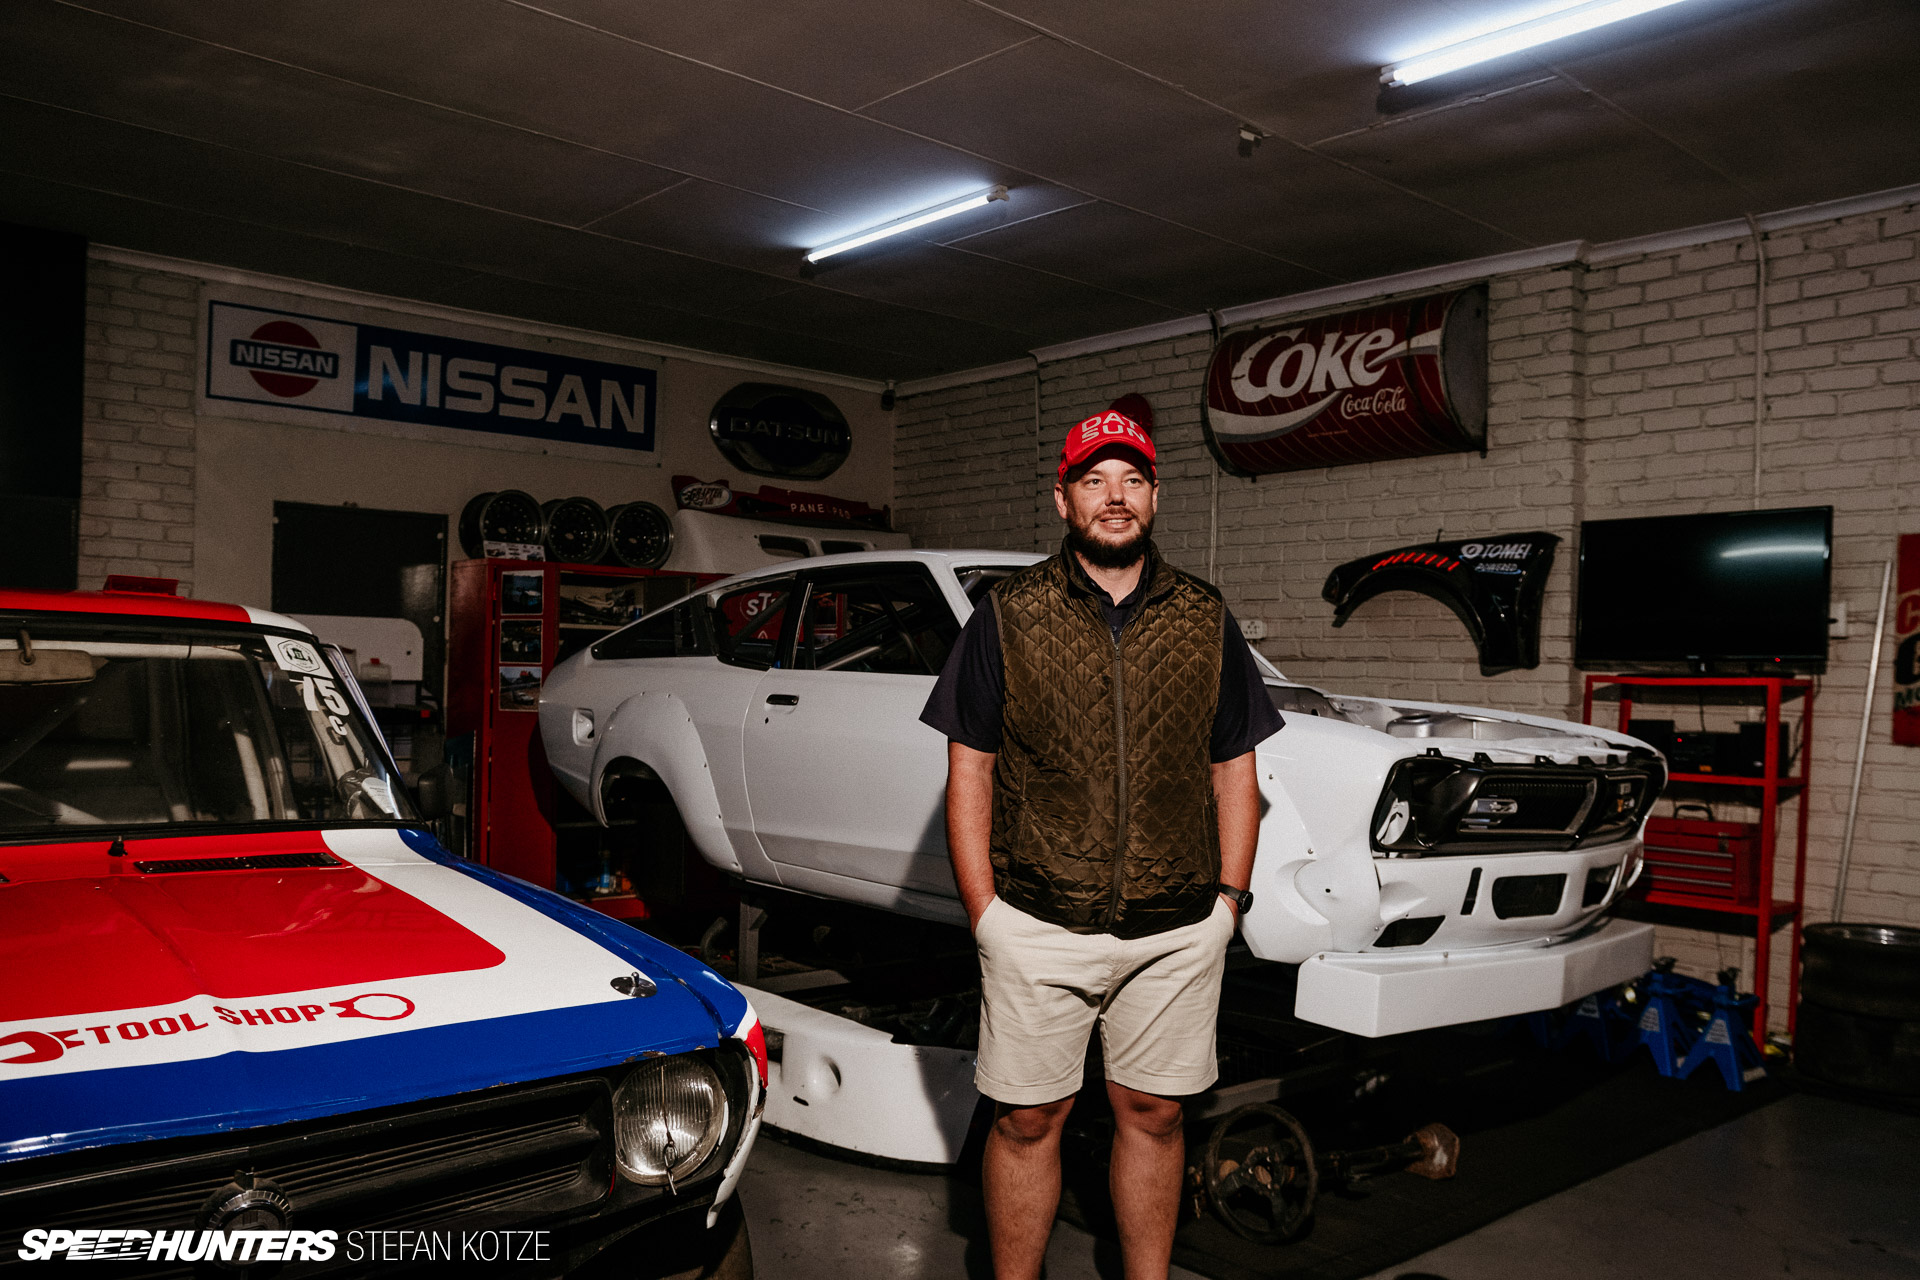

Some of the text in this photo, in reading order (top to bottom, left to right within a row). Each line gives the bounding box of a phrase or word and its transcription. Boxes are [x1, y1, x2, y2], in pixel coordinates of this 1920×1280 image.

[234, 345, 335, 374] NISSAN
[367, 345, 646, 434] NISSAN
[729, 416, 840, 446] DATSUN
[1481, 543, 1533, 560] TOMEI
[745, 592, 777, 616] ST
[86, 1005, 325, 1044] TOOL SHOP
